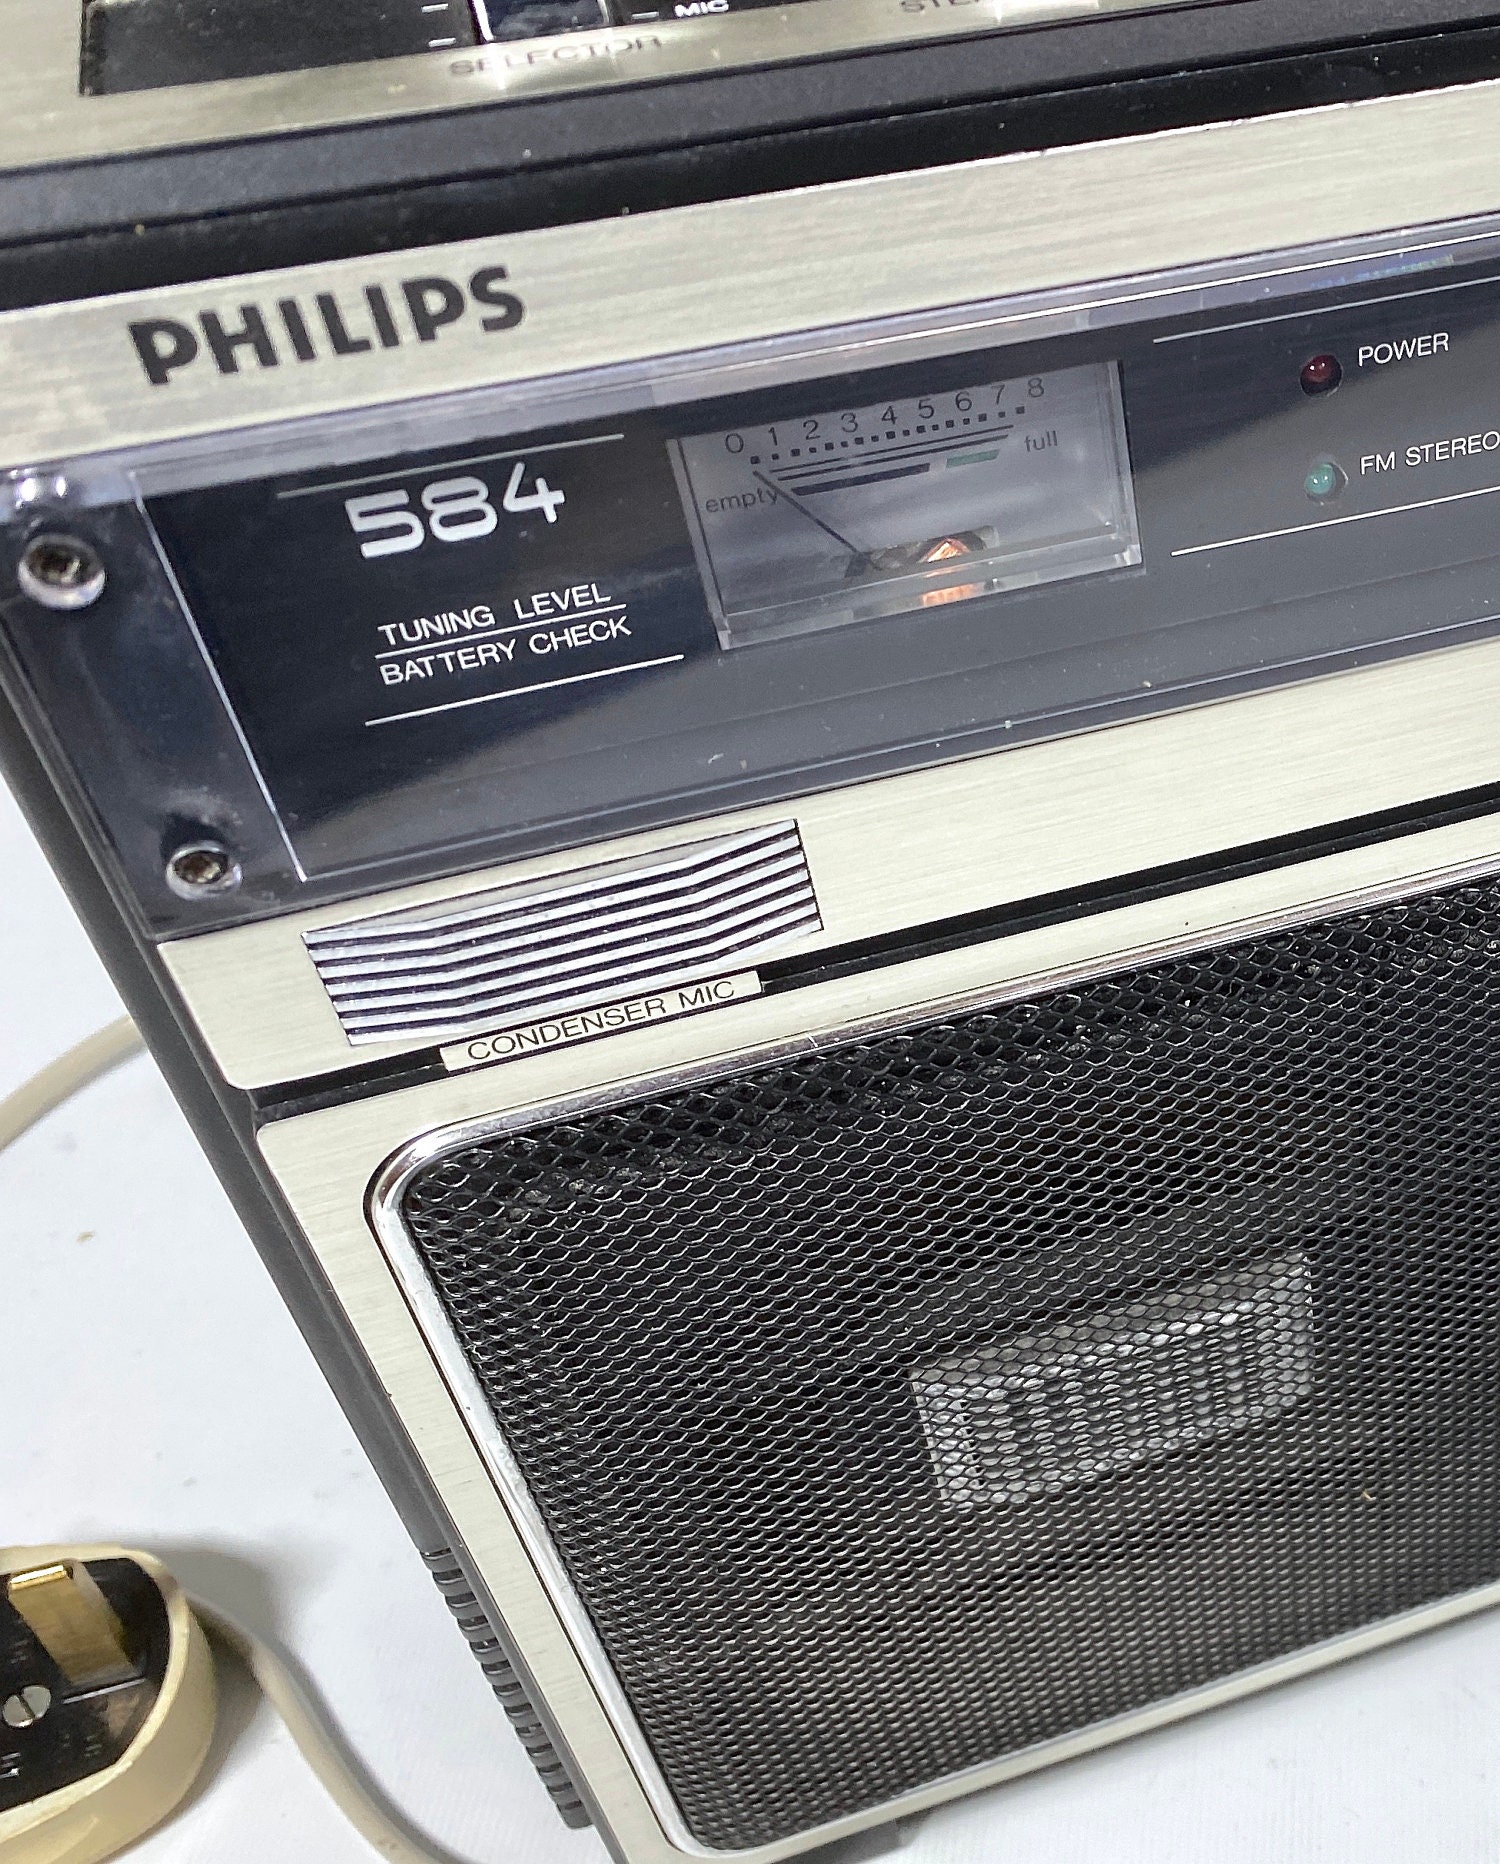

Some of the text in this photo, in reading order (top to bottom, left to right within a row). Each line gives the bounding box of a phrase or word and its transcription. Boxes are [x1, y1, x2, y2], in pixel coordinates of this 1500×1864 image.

[127, 267, 524, 385] PHILIPS
[1358, 332, 1450, 367] POWER
[725, 377, 1045, 454] 0 1 2 3 4 5 6 7 8
[1024, 430, 1059, 453] full
[1360, 431, 1500, 475] FM STEREO
[345, 461, 565, 559] 584
[706, 487, 780, 515] empty
[378, 583, 612, 645] TUNING LEVEL
[380, 615, 632, 685] BATTERY CHECK
[467, 980, 735, 1061] CONDENSER MIC
